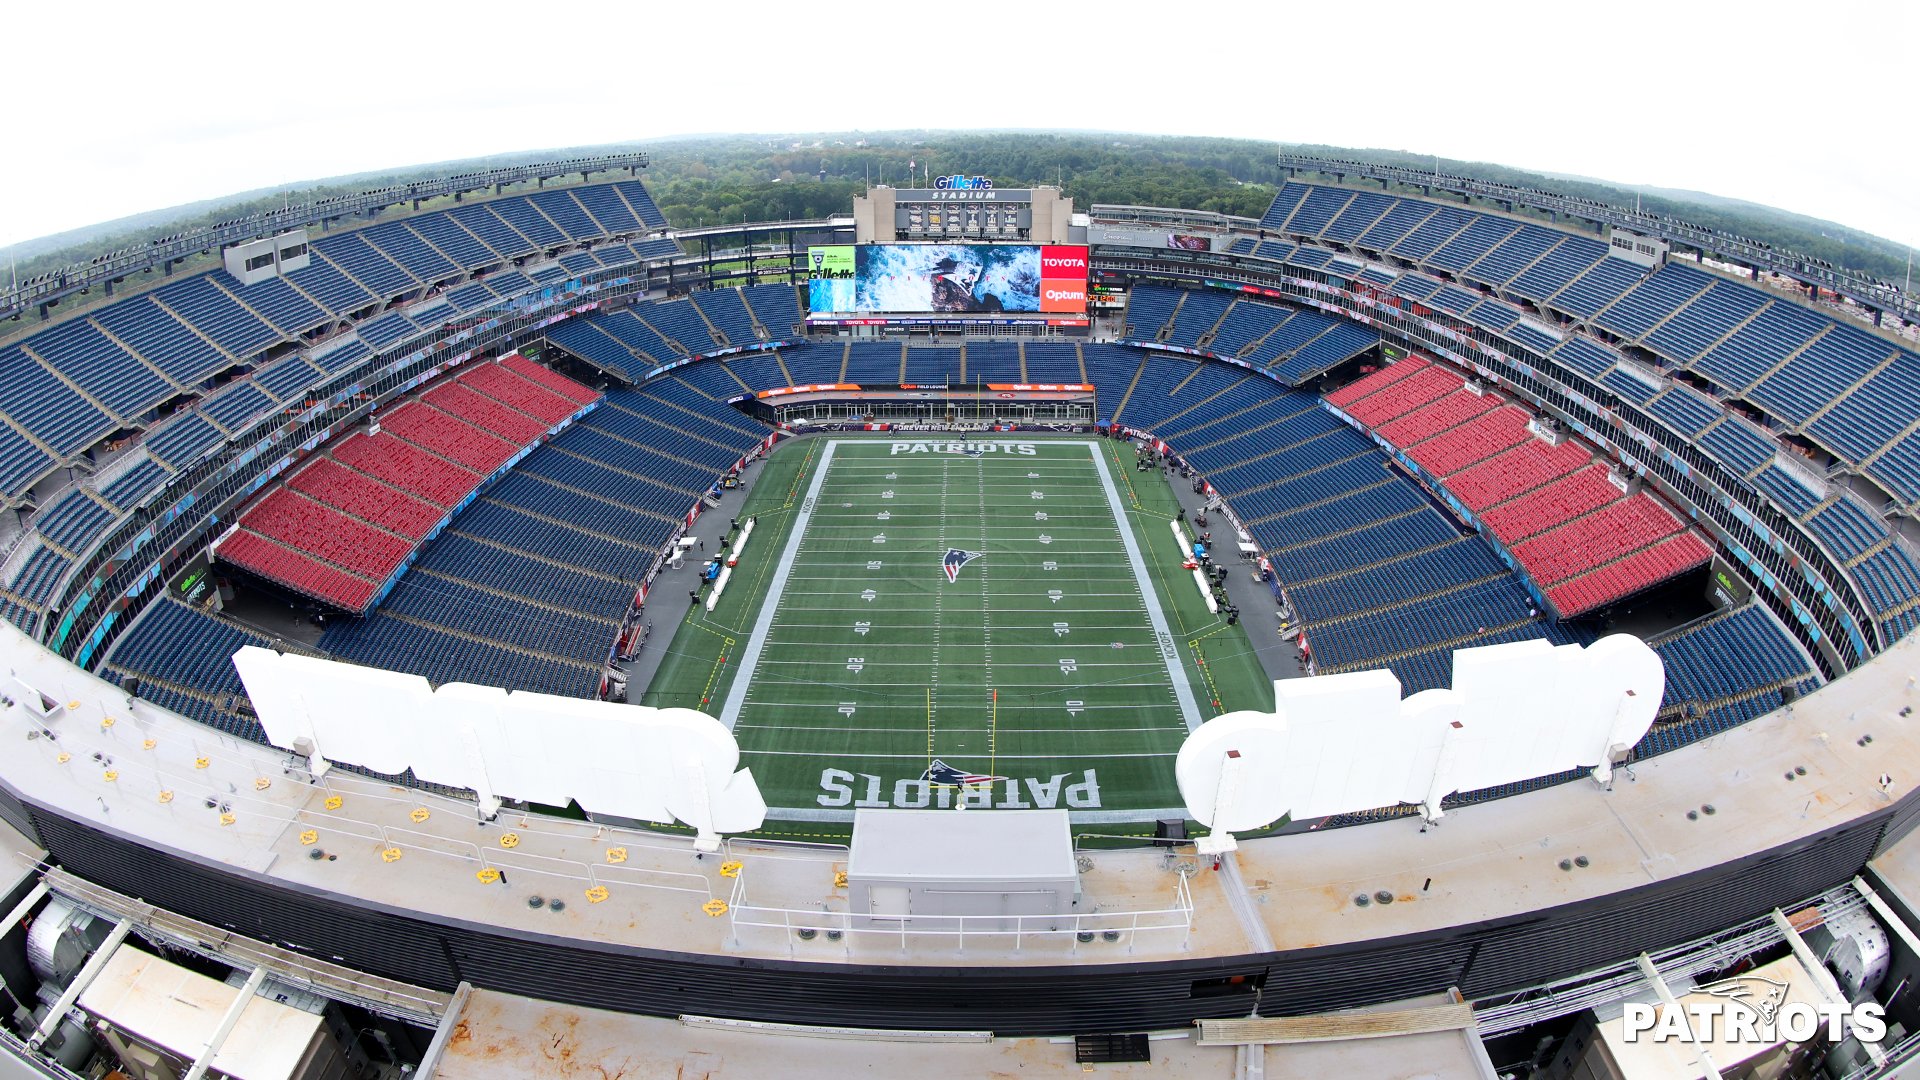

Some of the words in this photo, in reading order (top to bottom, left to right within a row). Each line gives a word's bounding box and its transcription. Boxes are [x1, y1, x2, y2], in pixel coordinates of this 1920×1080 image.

[934, 175, 993, 190] Gillette
[1043, 258, 1085, 267] TOYOTA
[1046, 290, 1084, 302] Optum
[890, 443, 1037, 455] PATRIOTS
[1158, 631, 1177, 660] KICKOFF
[816, 767, 1102, 809] PATRIOTS
